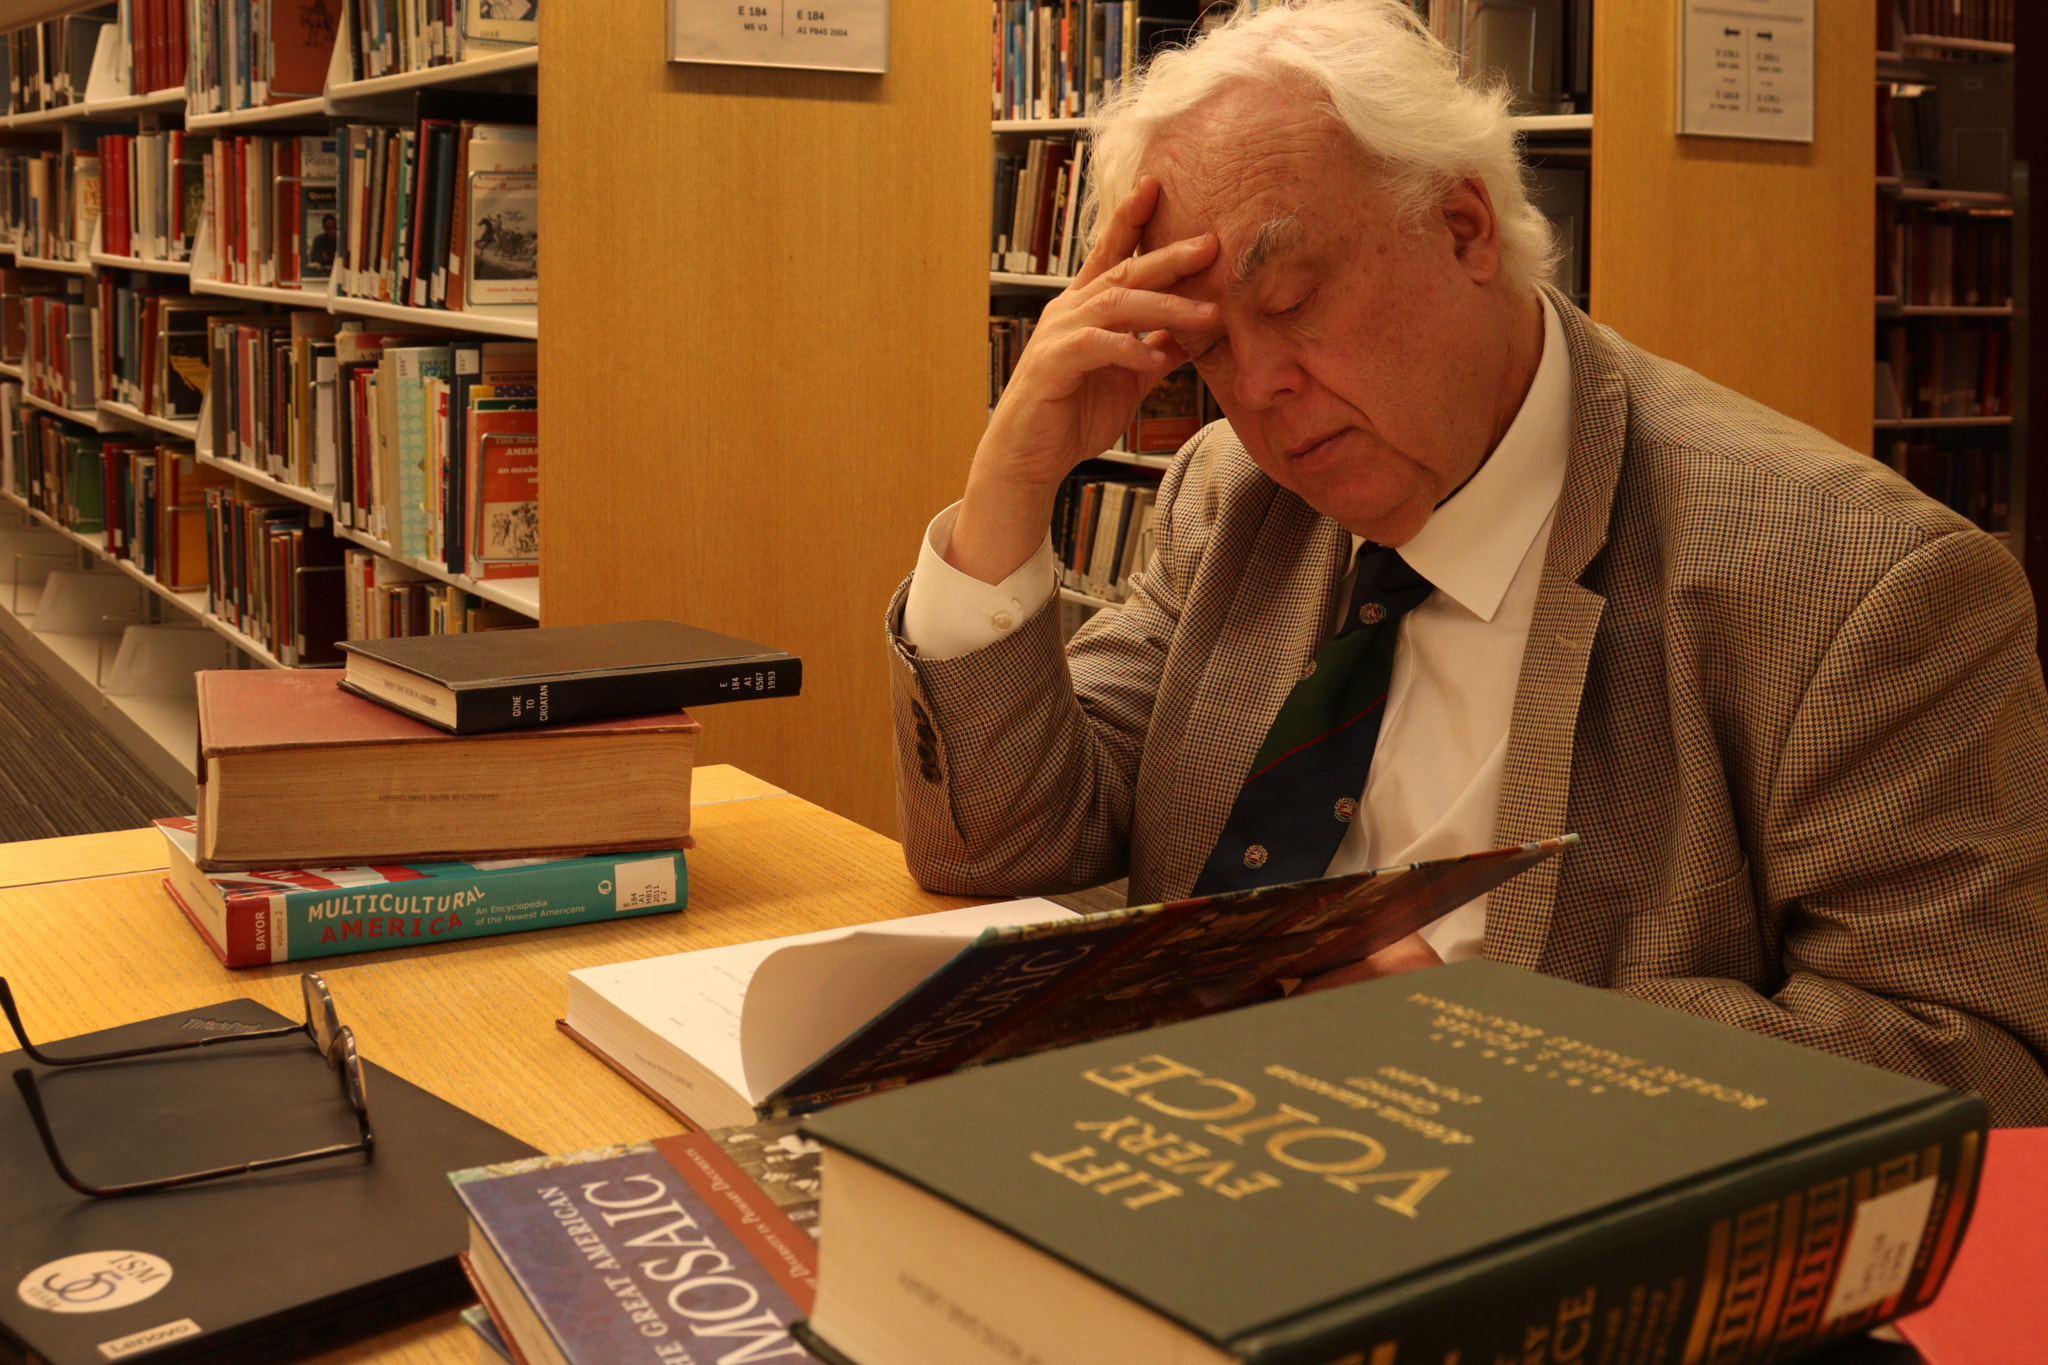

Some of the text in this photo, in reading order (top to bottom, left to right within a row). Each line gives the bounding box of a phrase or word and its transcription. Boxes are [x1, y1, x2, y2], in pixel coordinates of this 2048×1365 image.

[738, 6, 767, 16] E 184
[797, 10, 824, 20] E 184
[830, 28, 847, 36] 2004
[512, 695, 521, 717] GONE
[526, 699, 535, 710] TO
[539, 685, 548, 721] CROATAN
[308, 886, 486, 923] MULTICULTURAL
[475, 900, 547, 915] An Encyclopedia
[487, 915, 502, 923] the
[505, 911, 536, 922] Newest
[540, 905, 585, 917] Americans
[255, 911, 266, 950] BAYOR
[275, 919, 283, 947] volume
[320, 912, 462, 945] AMERICA
[872, 944, 1096, 1072] MOSAIC
[181, 1018, 263, 1033] ThinkPad
[1080, 1054, 1452, 1219] VOICE
[1074, 1115, 1283, 1201] EVERY
[1030, 1146, 1184, 1211] LIFT
[108, 1254, 168, 1285] ISM
[537, 1186, 698, 1365] HE GREAT AMERICAN
[581, 1173, 809, 1365] MOSAIC
[109, 1324, 190, 1354] Lenovo
